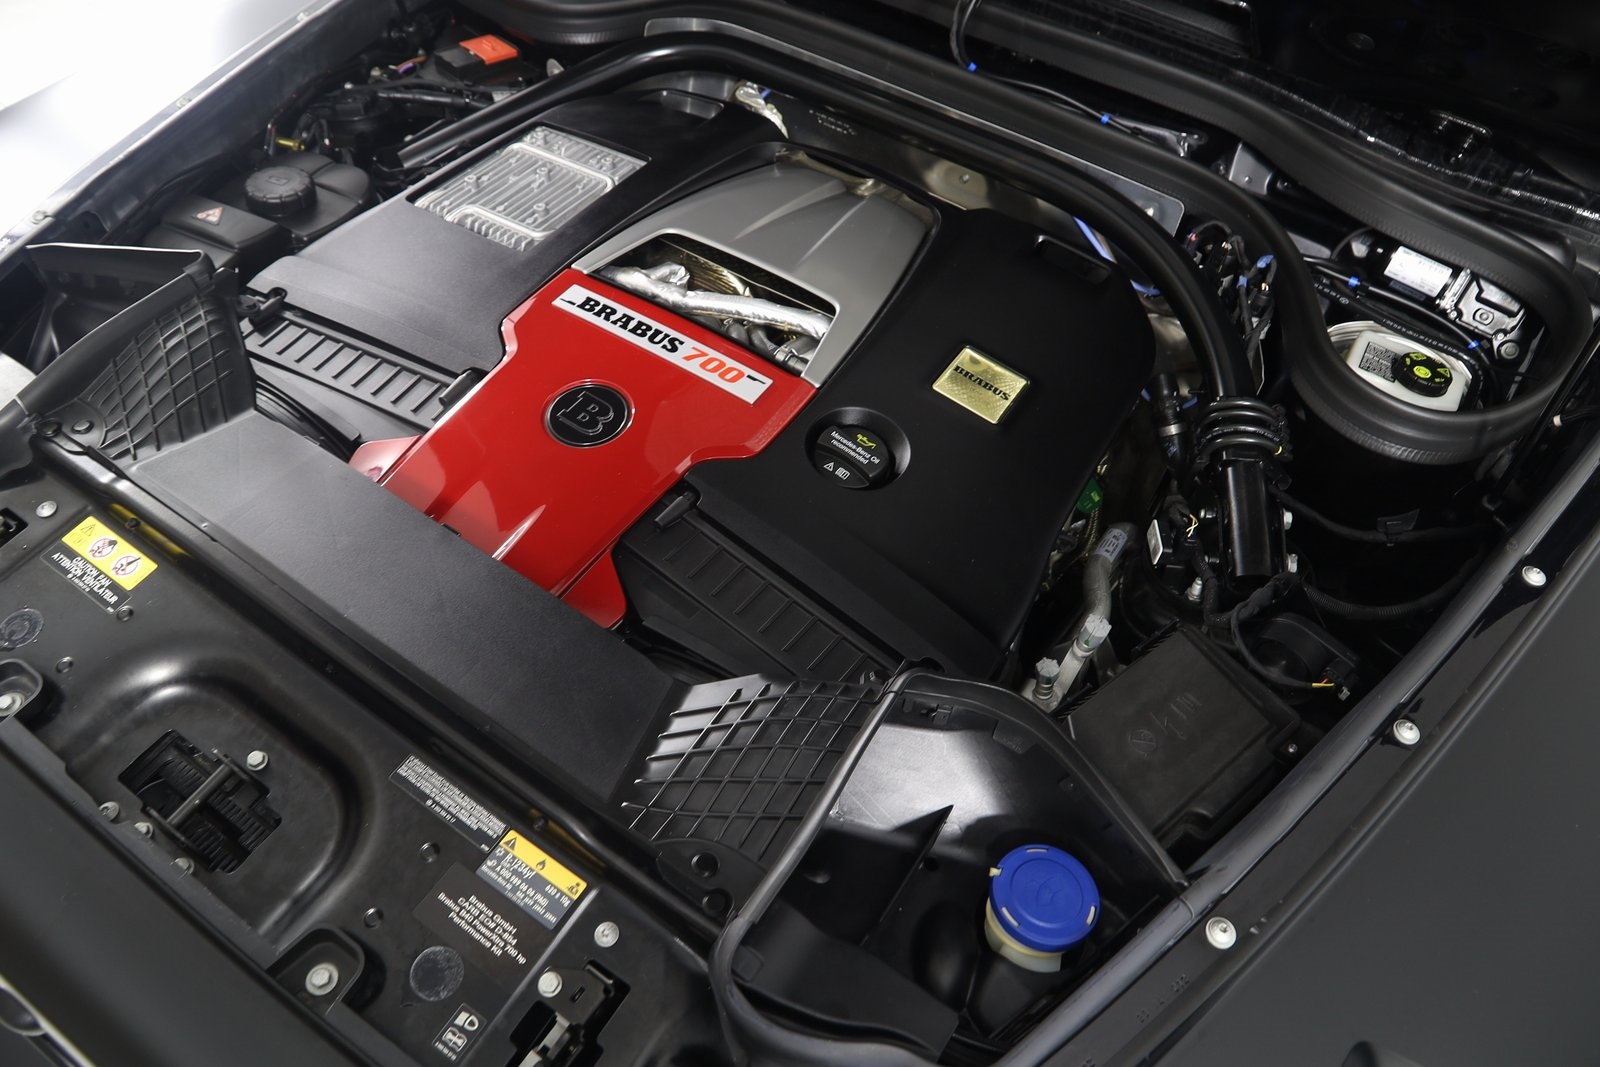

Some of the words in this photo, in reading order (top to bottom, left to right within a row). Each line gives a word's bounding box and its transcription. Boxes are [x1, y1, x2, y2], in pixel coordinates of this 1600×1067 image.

[577, 296, 684, 353] BRABUS
[682, 347, 745, 383] 700
[953, 365, 1011, 401] BRABUS
[831, 431, 871, 458] Mercedes-Benz
[870, 455, 880, 464] Oil
[831, 439, 869, 464] recommended
[51, 551, 84, 577] ATTENTION
[80, 574, 118, 604] VENTILATEUR
[73, 556, 99, 577] CAUTION
[96, 573, 112, 587] FAN
[438, 892, 460, 912] Brabus
[504, 944, 519, 957] 700
[516, 953, 527, 964] hp
[448, 911, 492, 948] Performance
[491, 944, 503, 957] Kit
[469, 895, 493, 916] Brabus
[493, 914, 517, 934] GmbH
